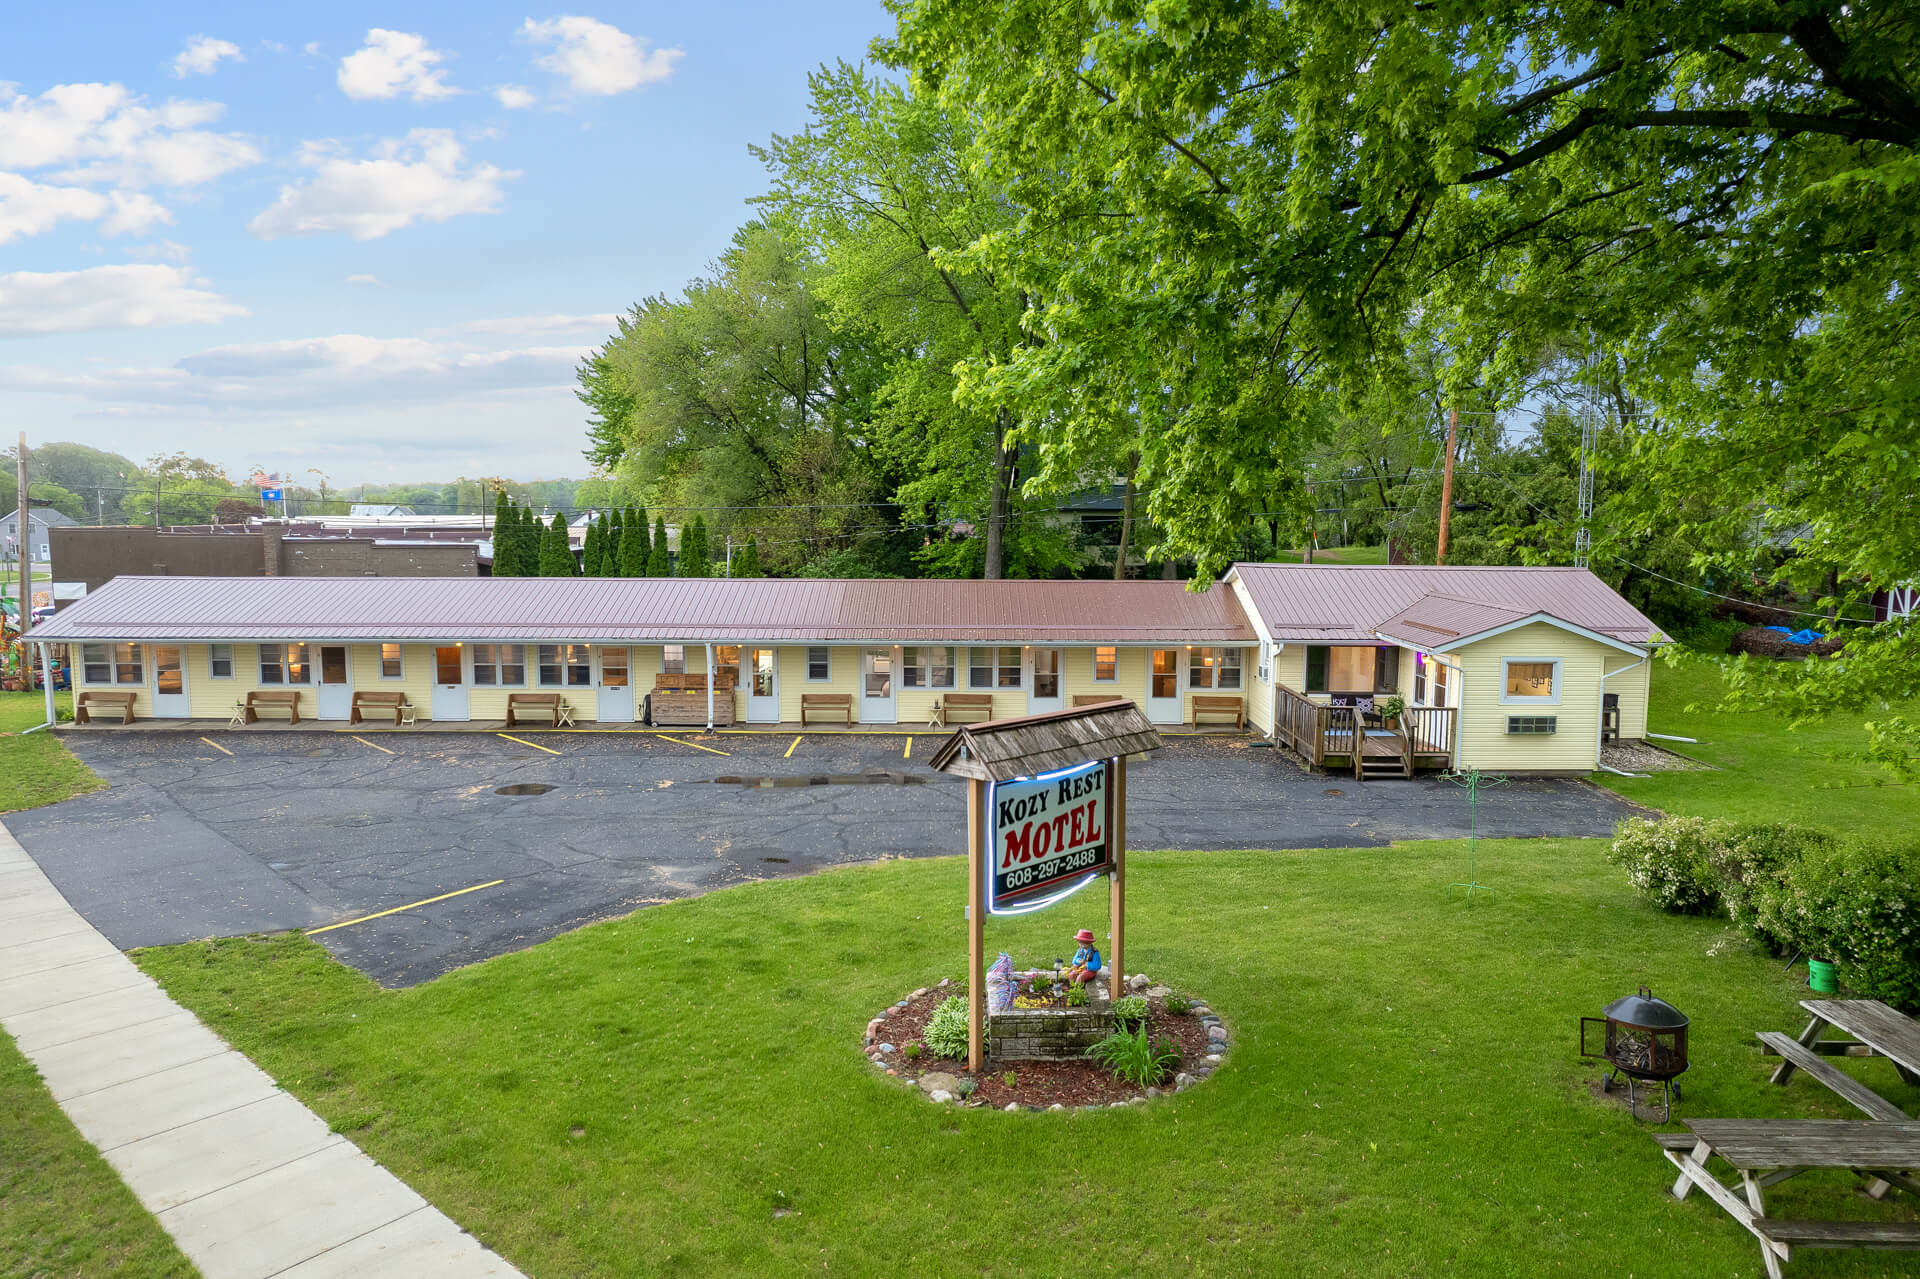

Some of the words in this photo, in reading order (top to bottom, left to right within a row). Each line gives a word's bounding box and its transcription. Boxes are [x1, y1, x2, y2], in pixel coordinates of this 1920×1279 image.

[999, 790, 1050, 828] KOZY
[1058, 770, 1104, 805] REST
[1001, 800, 1101, 869] MOTEL
[1006, 849, 1096, 889] 608-297-2488
